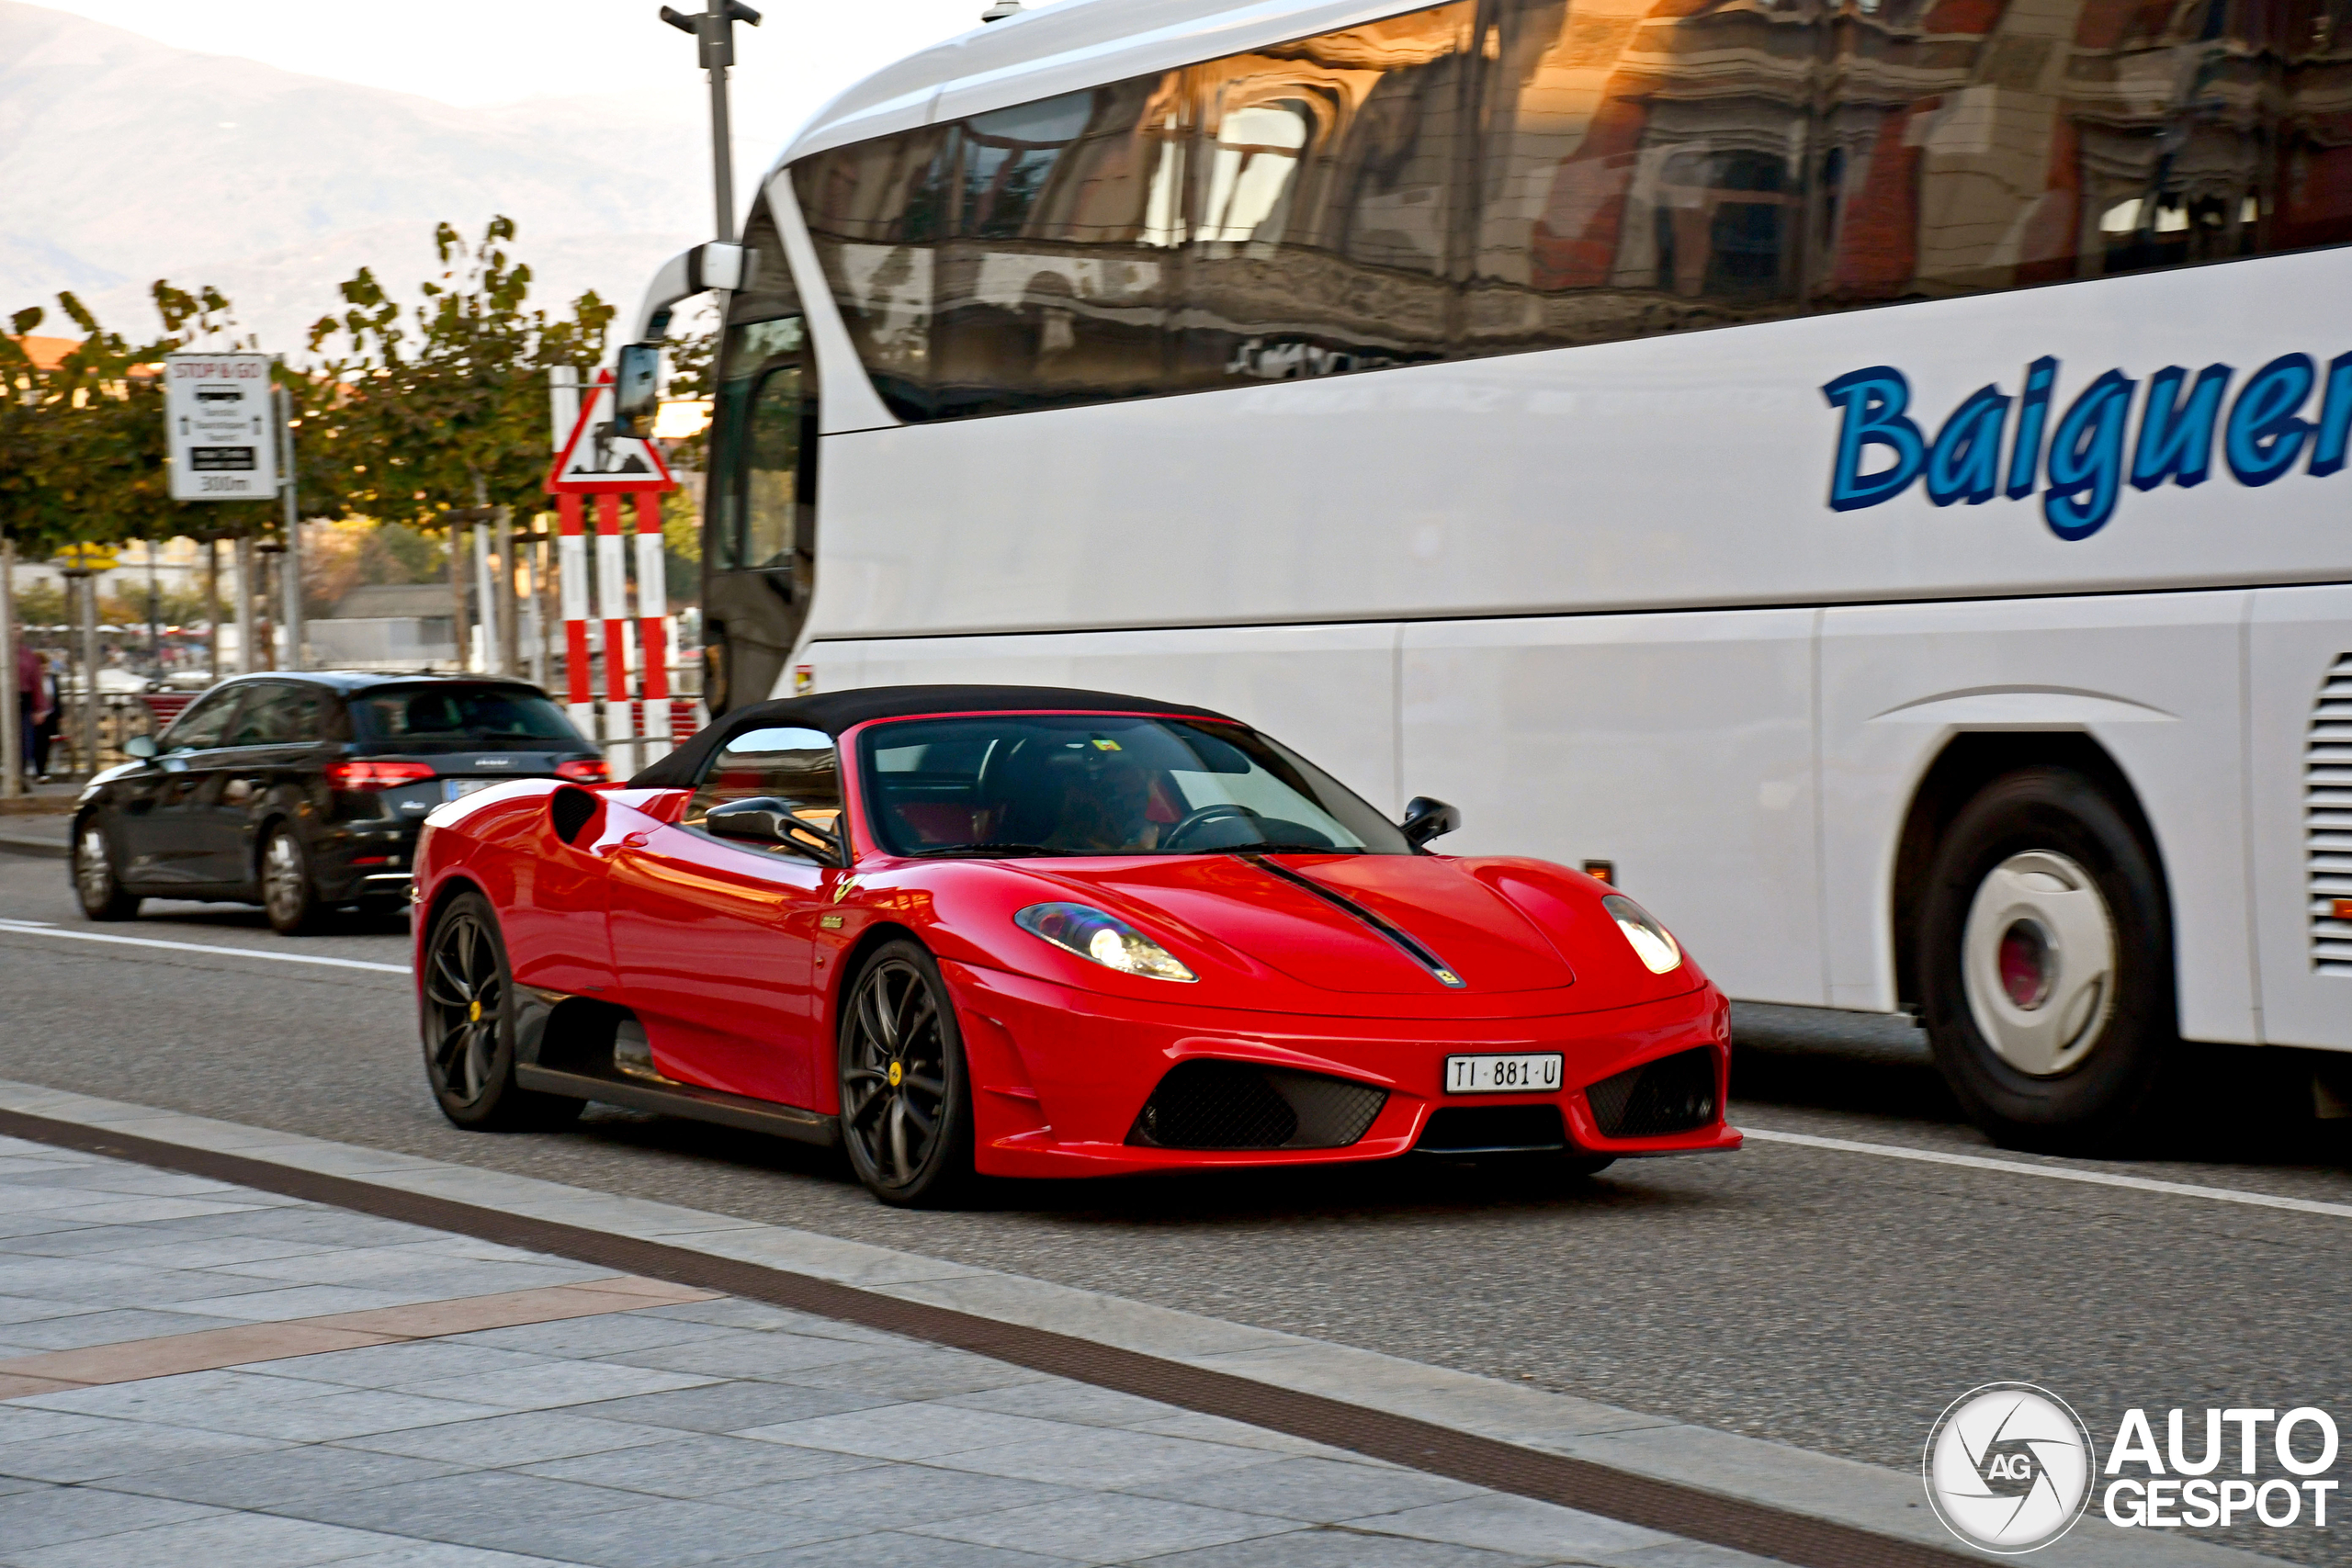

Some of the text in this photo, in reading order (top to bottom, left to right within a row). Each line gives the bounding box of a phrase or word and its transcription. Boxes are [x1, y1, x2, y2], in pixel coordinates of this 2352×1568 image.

[173, 363, 216, 378] STOP
[235, 363, 262, 378] GO
[1454, 1058, 1556, 1087] TI 881 U
